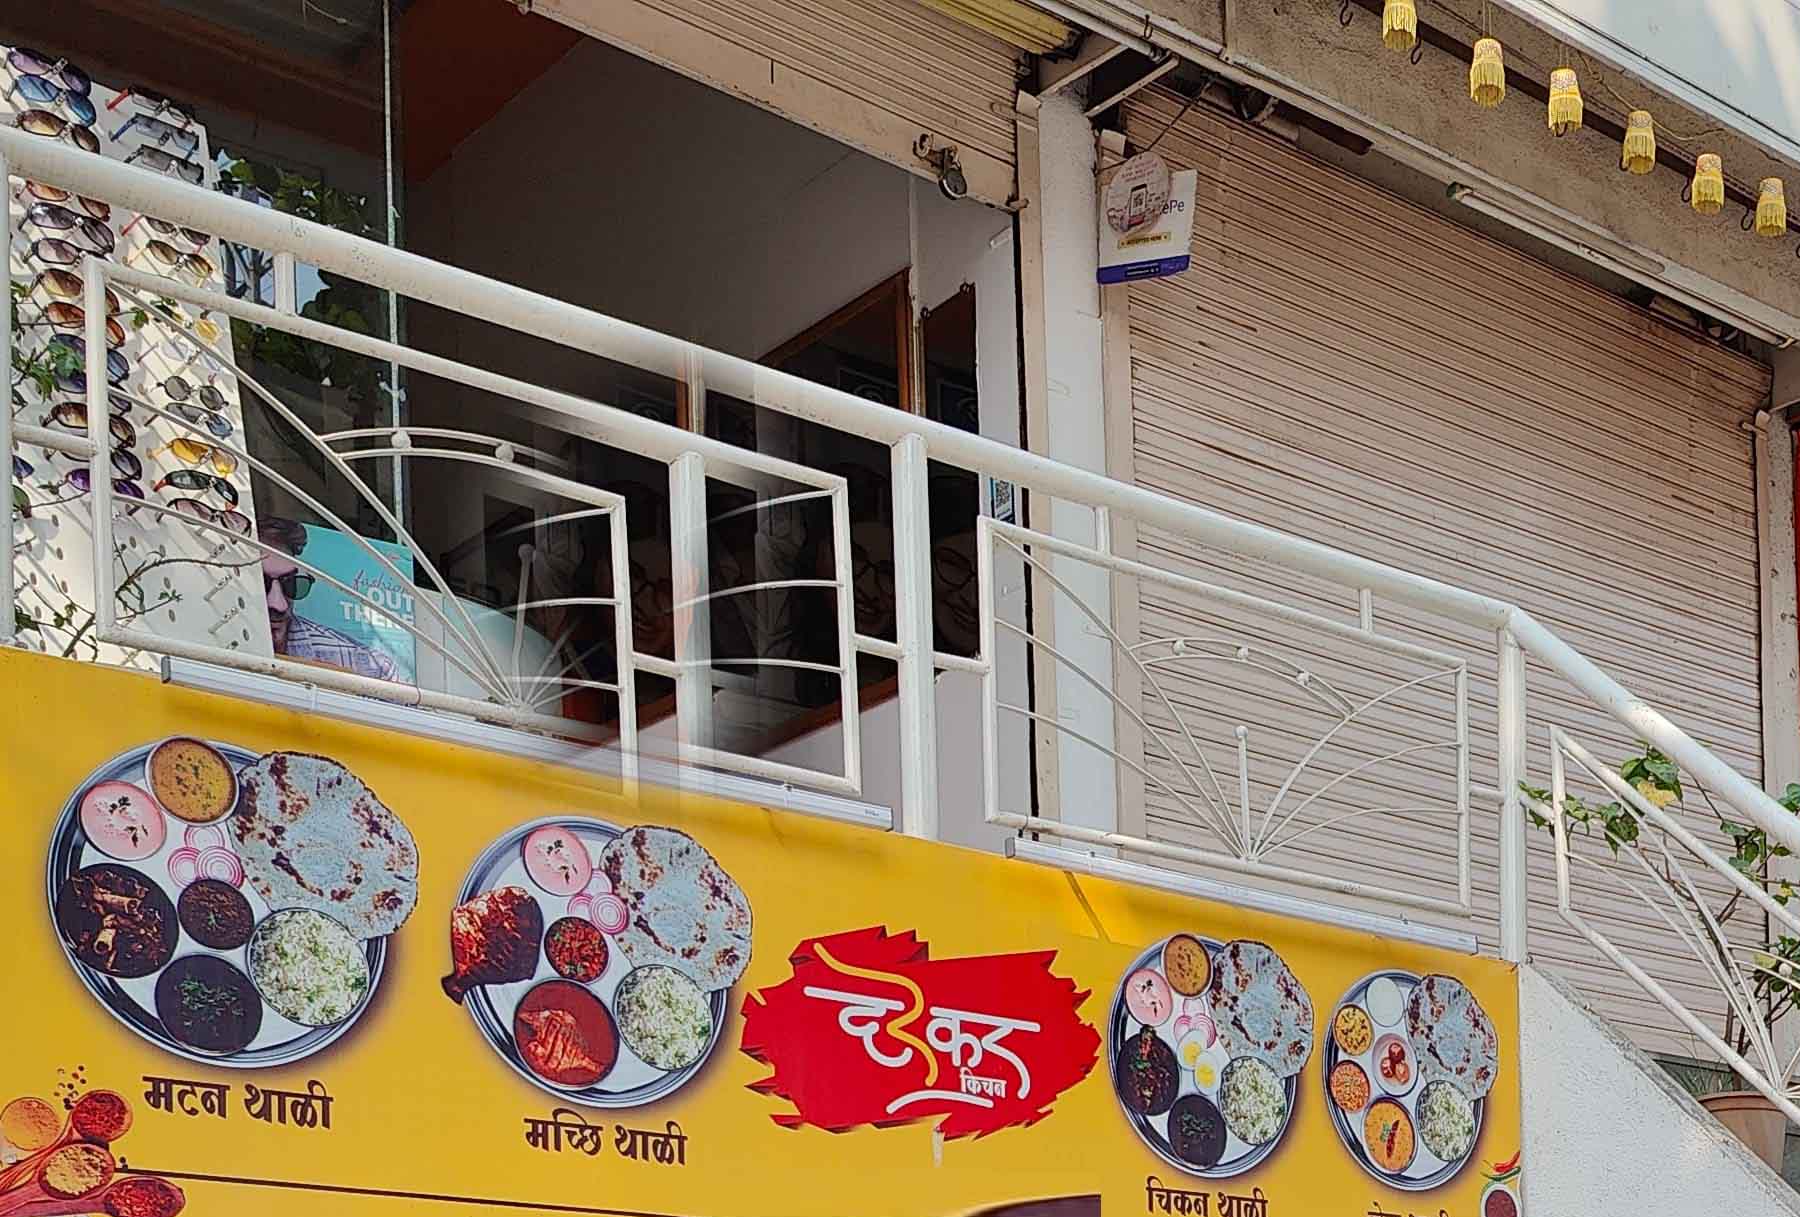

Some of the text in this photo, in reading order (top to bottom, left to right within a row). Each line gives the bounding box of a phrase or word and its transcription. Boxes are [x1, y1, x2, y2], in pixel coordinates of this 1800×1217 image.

[367, 587, 415, 614] OUT
[142, 1076, 334, 1130] मटन थाळी
[959, 1066, 1007, 1099] किचन
[524, 1108, 688, 1165] मच्छि थाळी
